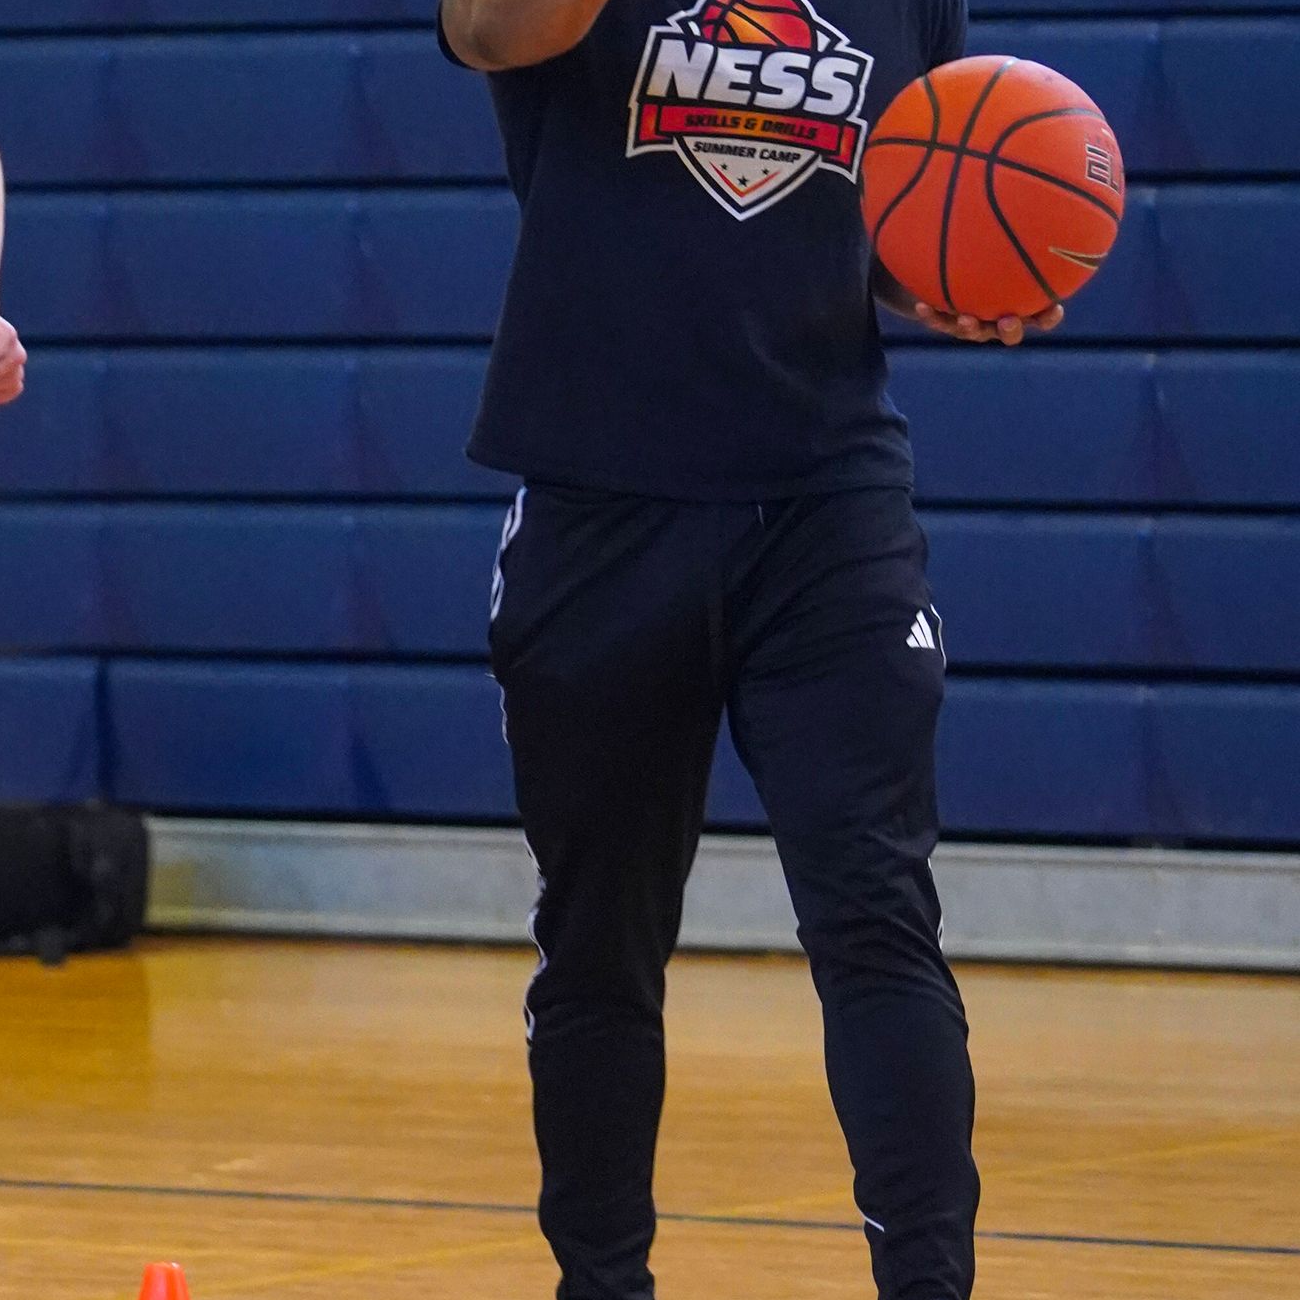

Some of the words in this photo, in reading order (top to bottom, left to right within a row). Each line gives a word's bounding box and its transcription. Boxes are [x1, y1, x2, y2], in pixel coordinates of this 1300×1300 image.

[646, 38, 860, 116] NESS
[684, 114, 741, 128] SKILLS
[743, 117, 757, 130] &
[761, 120, 817, 140] DRILLS
[693, 141, 756, 158] SUMMER
[760, 148, 801, 163] CAMP
